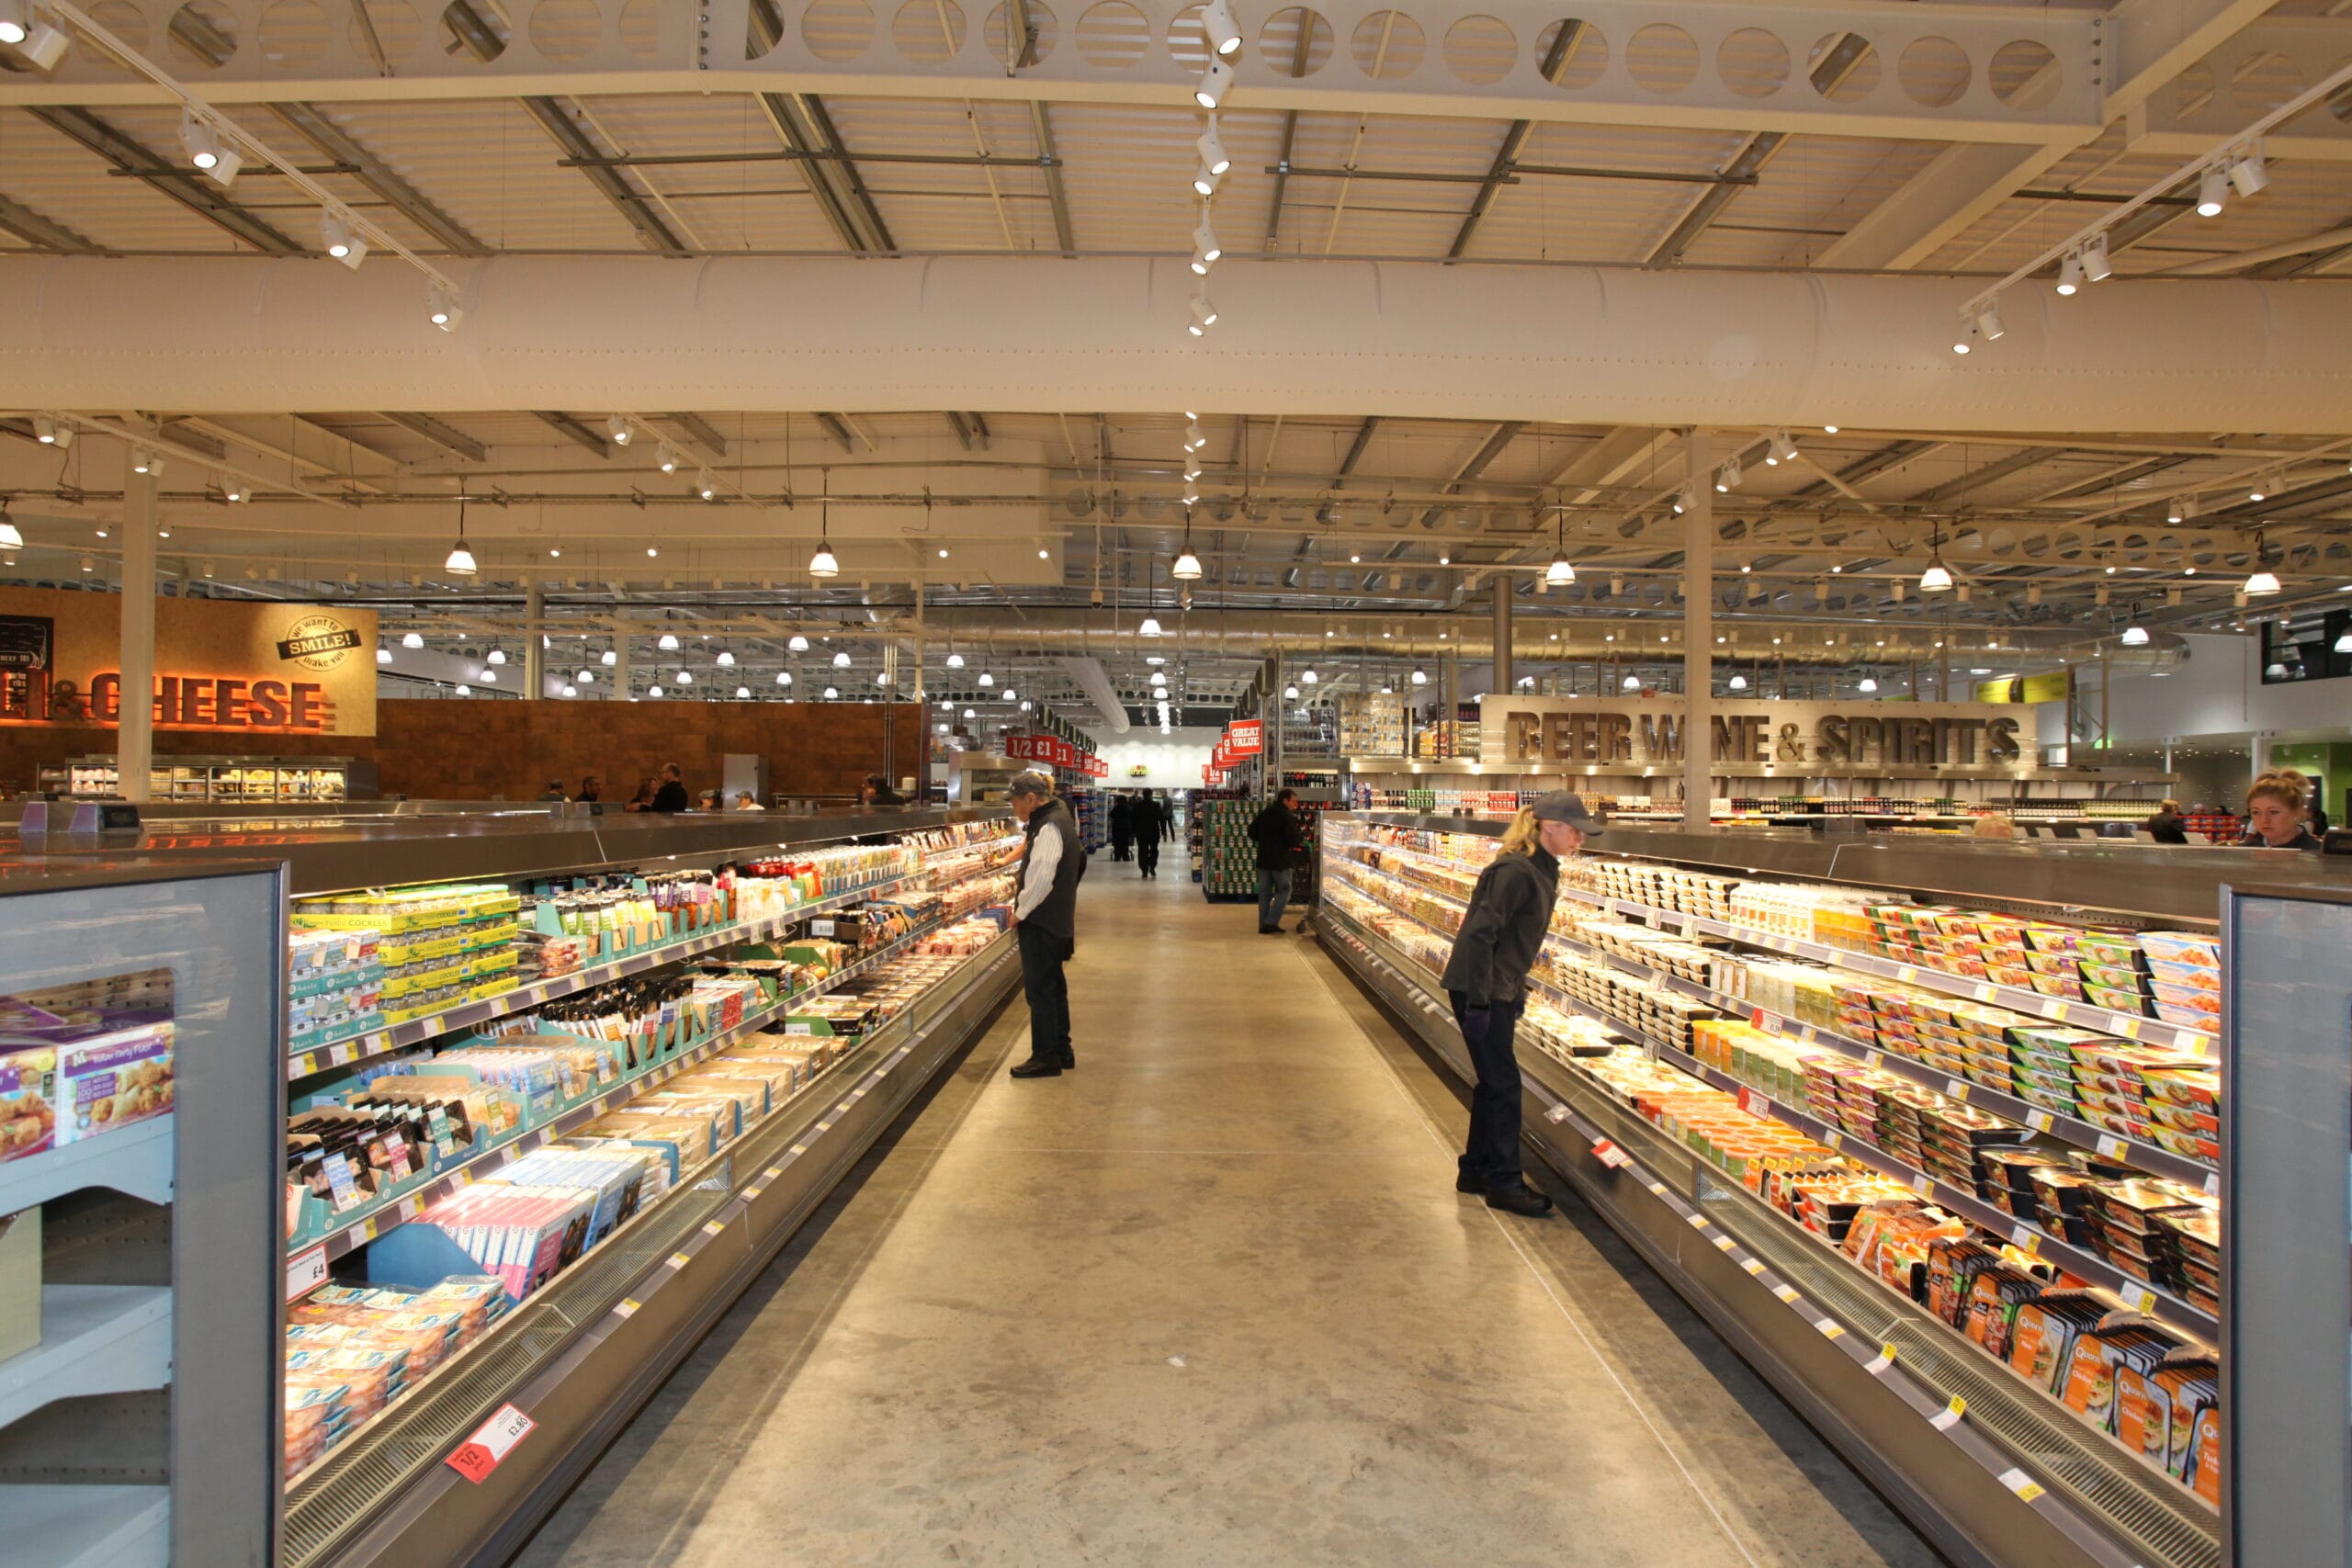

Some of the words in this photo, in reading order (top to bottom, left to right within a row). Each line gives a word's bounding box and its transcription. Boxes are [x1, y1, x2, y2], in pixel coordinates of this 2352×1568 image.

[303, 619, 328, 627] want
[328, 620, 339, 631] to
[288, 633, 352, 655] SMILE!
[303, 657, 329, 668] make
[330, 650, 345, 664] you
[91, 672, 321, 728] CHEESE
[1232, 728, 1260, 738] GREAT
[1508, 712, 1631, 761] BEER
[1639, 714, 1770, 762] WNE
[1777, 723, 1806, 762] &
[1815, 715, 2019, 764] SPIRITS
[1012, 739, 1033, 758] 1/2
[1037, 740, 1051, 756] £1
[1233, 737, 1260, 747] VALUE
[313, 1264, 324, 1279] £4
[2019, 1315, 2043, 1332] Quorn
[2075, 1347, 2100, 1364] Quorn
[2120, 1381, 2146, 1401] Quorn
[508, 1417, 528, 1437] £2.80
[460, 1450, 480, 1466] 1/2
